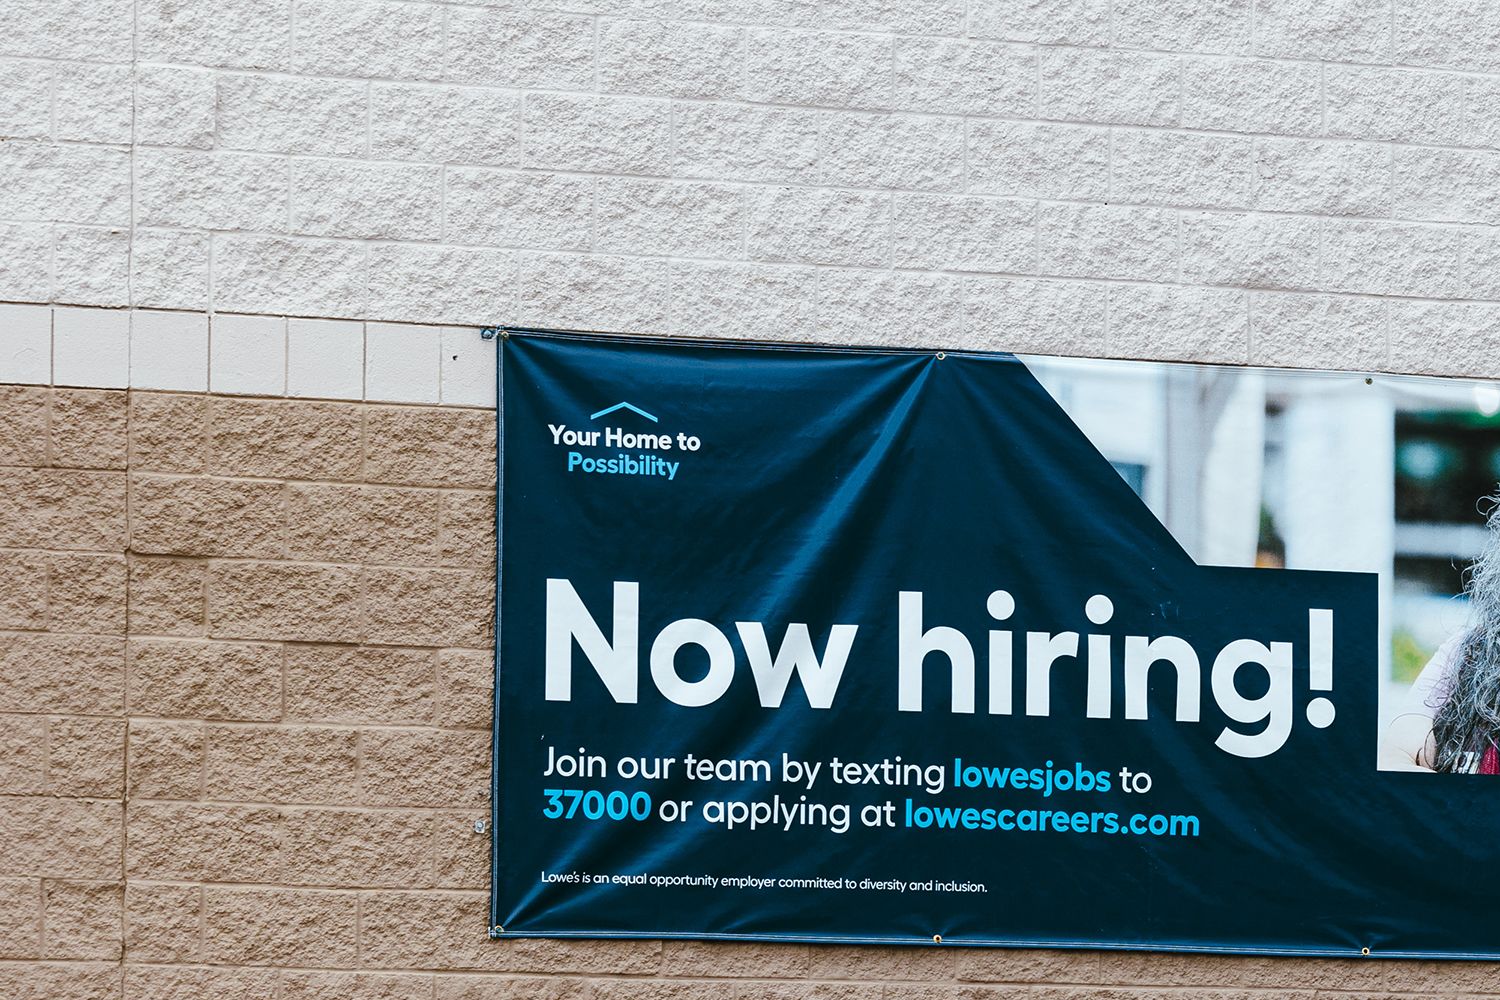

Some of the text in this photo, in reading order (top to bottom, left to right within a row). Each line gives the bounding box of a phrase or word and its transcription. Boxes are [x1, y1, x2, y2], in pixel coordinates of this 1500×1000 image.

[548, 425, 700, 451] Your Home to
[569, 452, 679, 480] Possibility
[545, 578, 1337, 758] Now hiring!
[544, 747, 1152, 797] Join our team by texting lowesjobs to
[543, 789, 1199, 836] 37000 or applying at lowescareers.com
[542, 871, 987, 892] Lowe's is an equal opportunity employer committed to diversity and inclusion.
